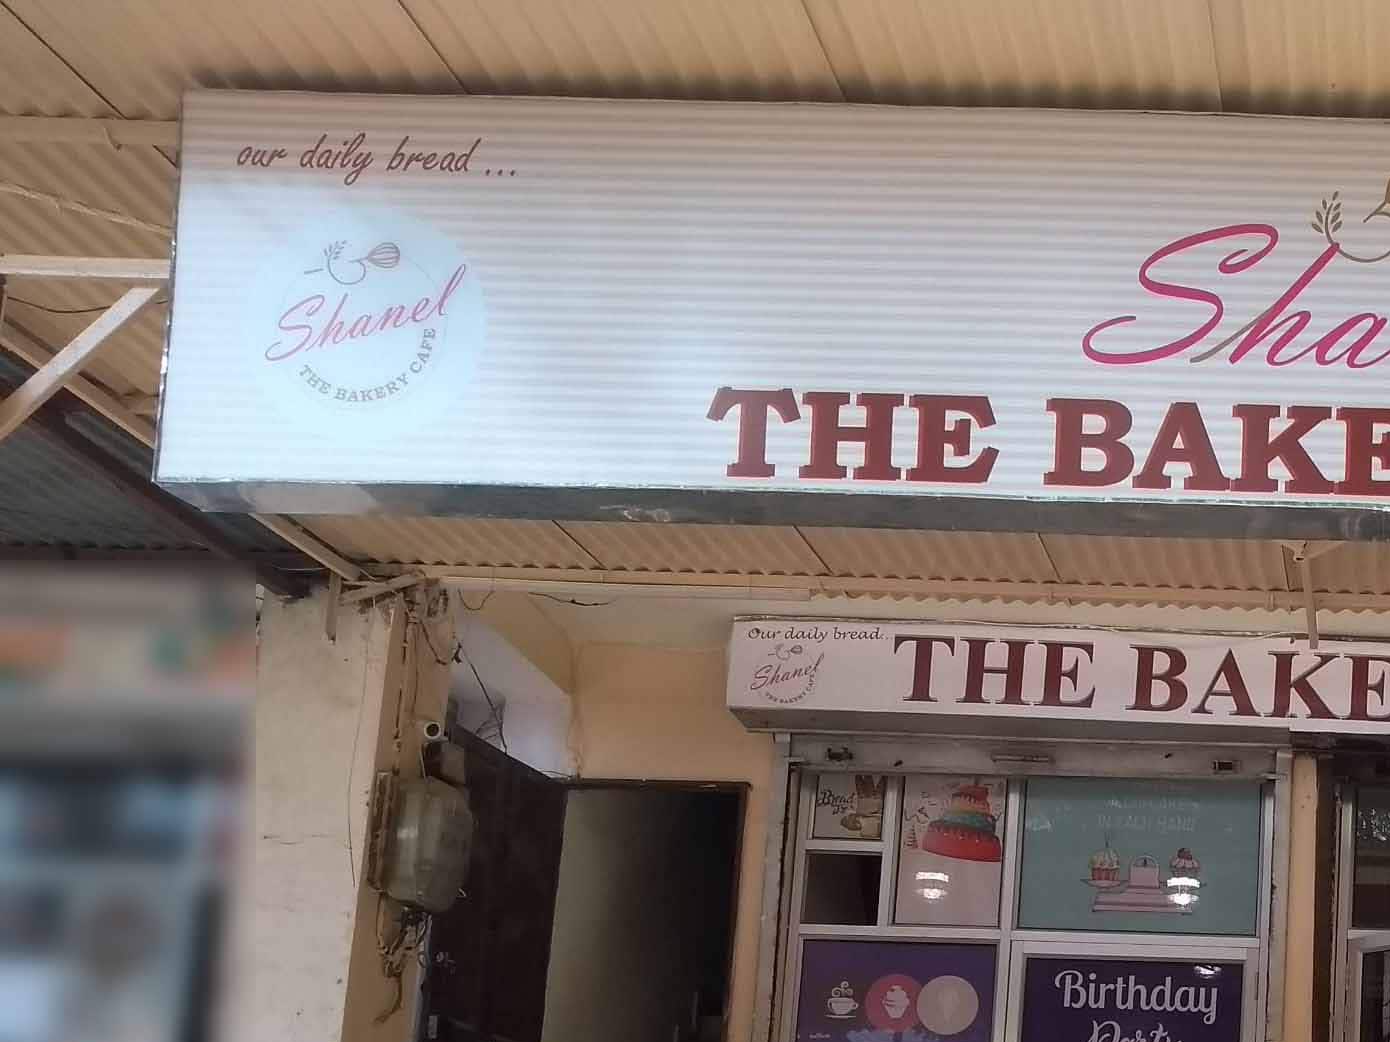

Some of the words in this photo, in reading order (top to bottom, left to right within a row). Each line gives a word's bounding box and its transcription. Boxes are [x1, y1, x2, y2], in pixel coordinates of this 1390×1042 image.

[237, 145, 288, 168] our
[299, 132, 374, 186] daily
[265, 263, 467, 361] Shanel
[299, 364, 330, 395] THE
[335, 373, 409, 402] BAKERY
[408, 327, 437, 374] CAFE
[707, 386, 1000, 484] THE
[748, 627, 781, 640] Our
[784, 626, 829, 643] daily
[750, 651, 825, 690] Shanel
[894, 635, 1096, 708] THE
[1055, 969, 1218, 1024] Birthday
